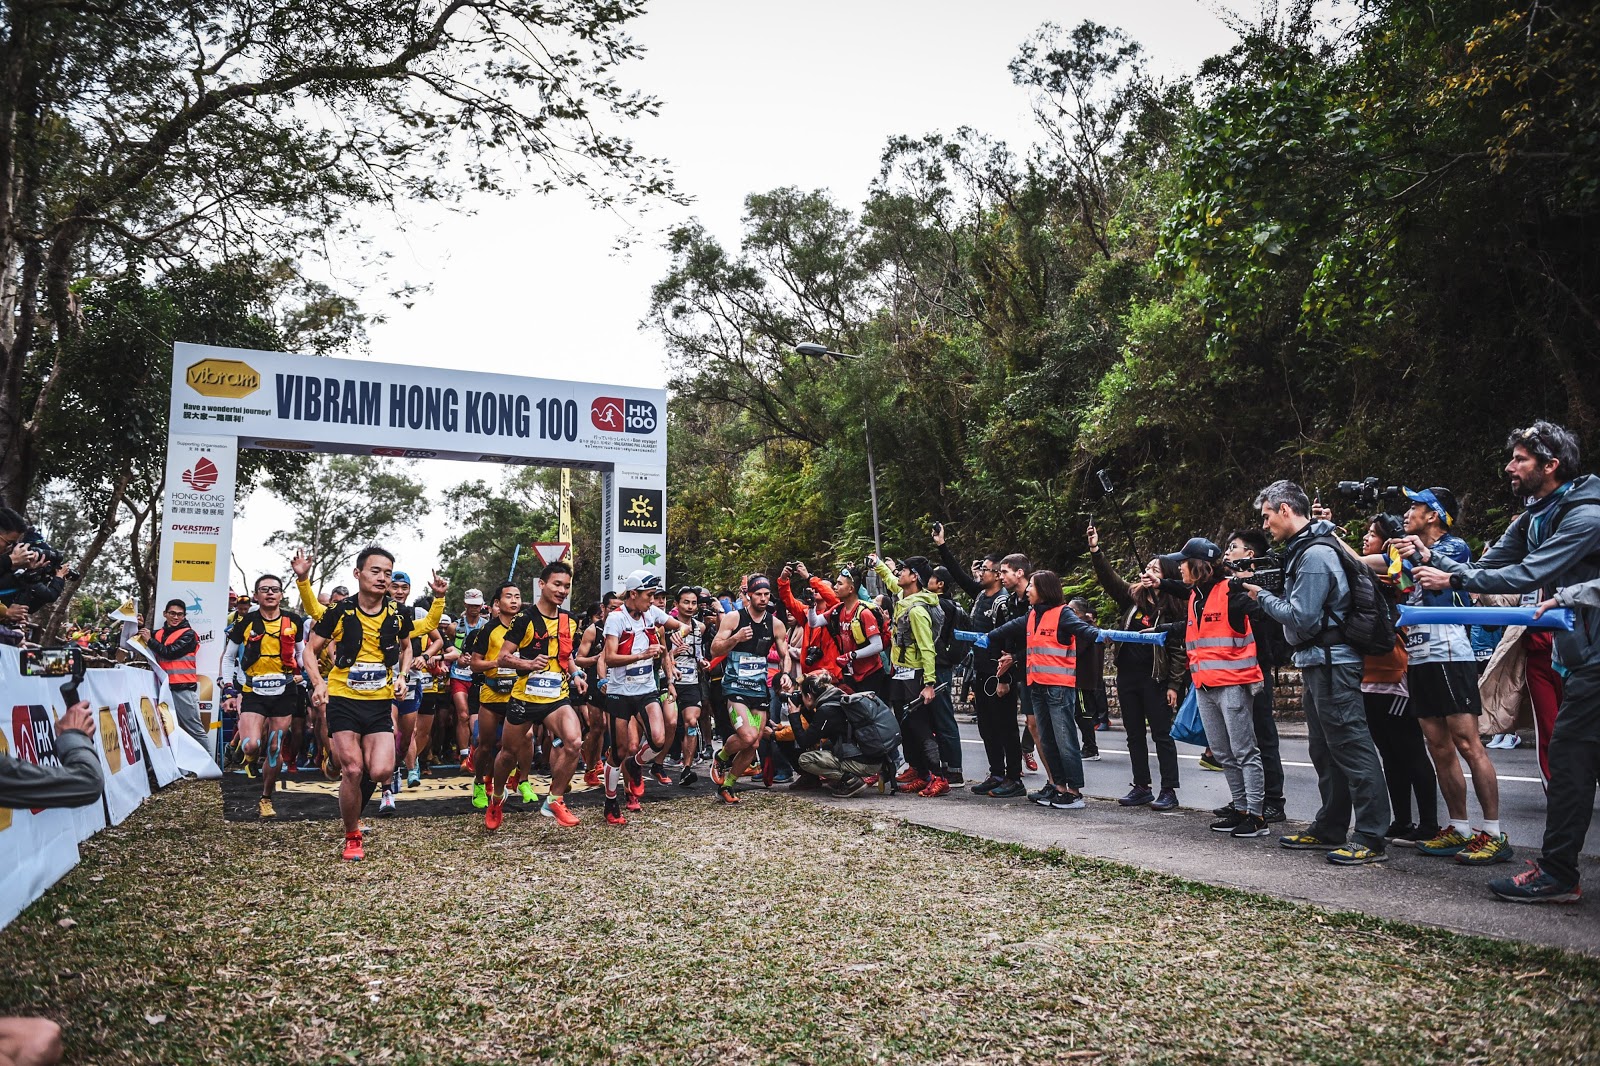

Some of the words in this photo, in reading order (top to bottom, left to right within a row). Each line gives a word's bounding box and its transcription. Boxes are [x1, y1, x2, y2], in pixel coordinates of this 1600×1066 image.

[183, 402, 200, 410] Have
[207, 405, 242, 414] wonderful
[243, 407, 272, 416] journey!
[275, 373, 382, 427] VIBRAM
[389, 383, 459, 432] HONG
[465, 390, 530, 438] KONG
[535, 397, 578, 442] 100
[629, 404, 653, 418] HK
[626, 416, 656, 430] 100
[172, 492, 198, 501] HONG
[200, 494, 224, 502] KONG
[623, 519, 658, 528] KAILAS
[618, 546, 655, 556] Bonaqua
[539, 679, 550, 687] 85
[34, 720, 52, 754] HK
